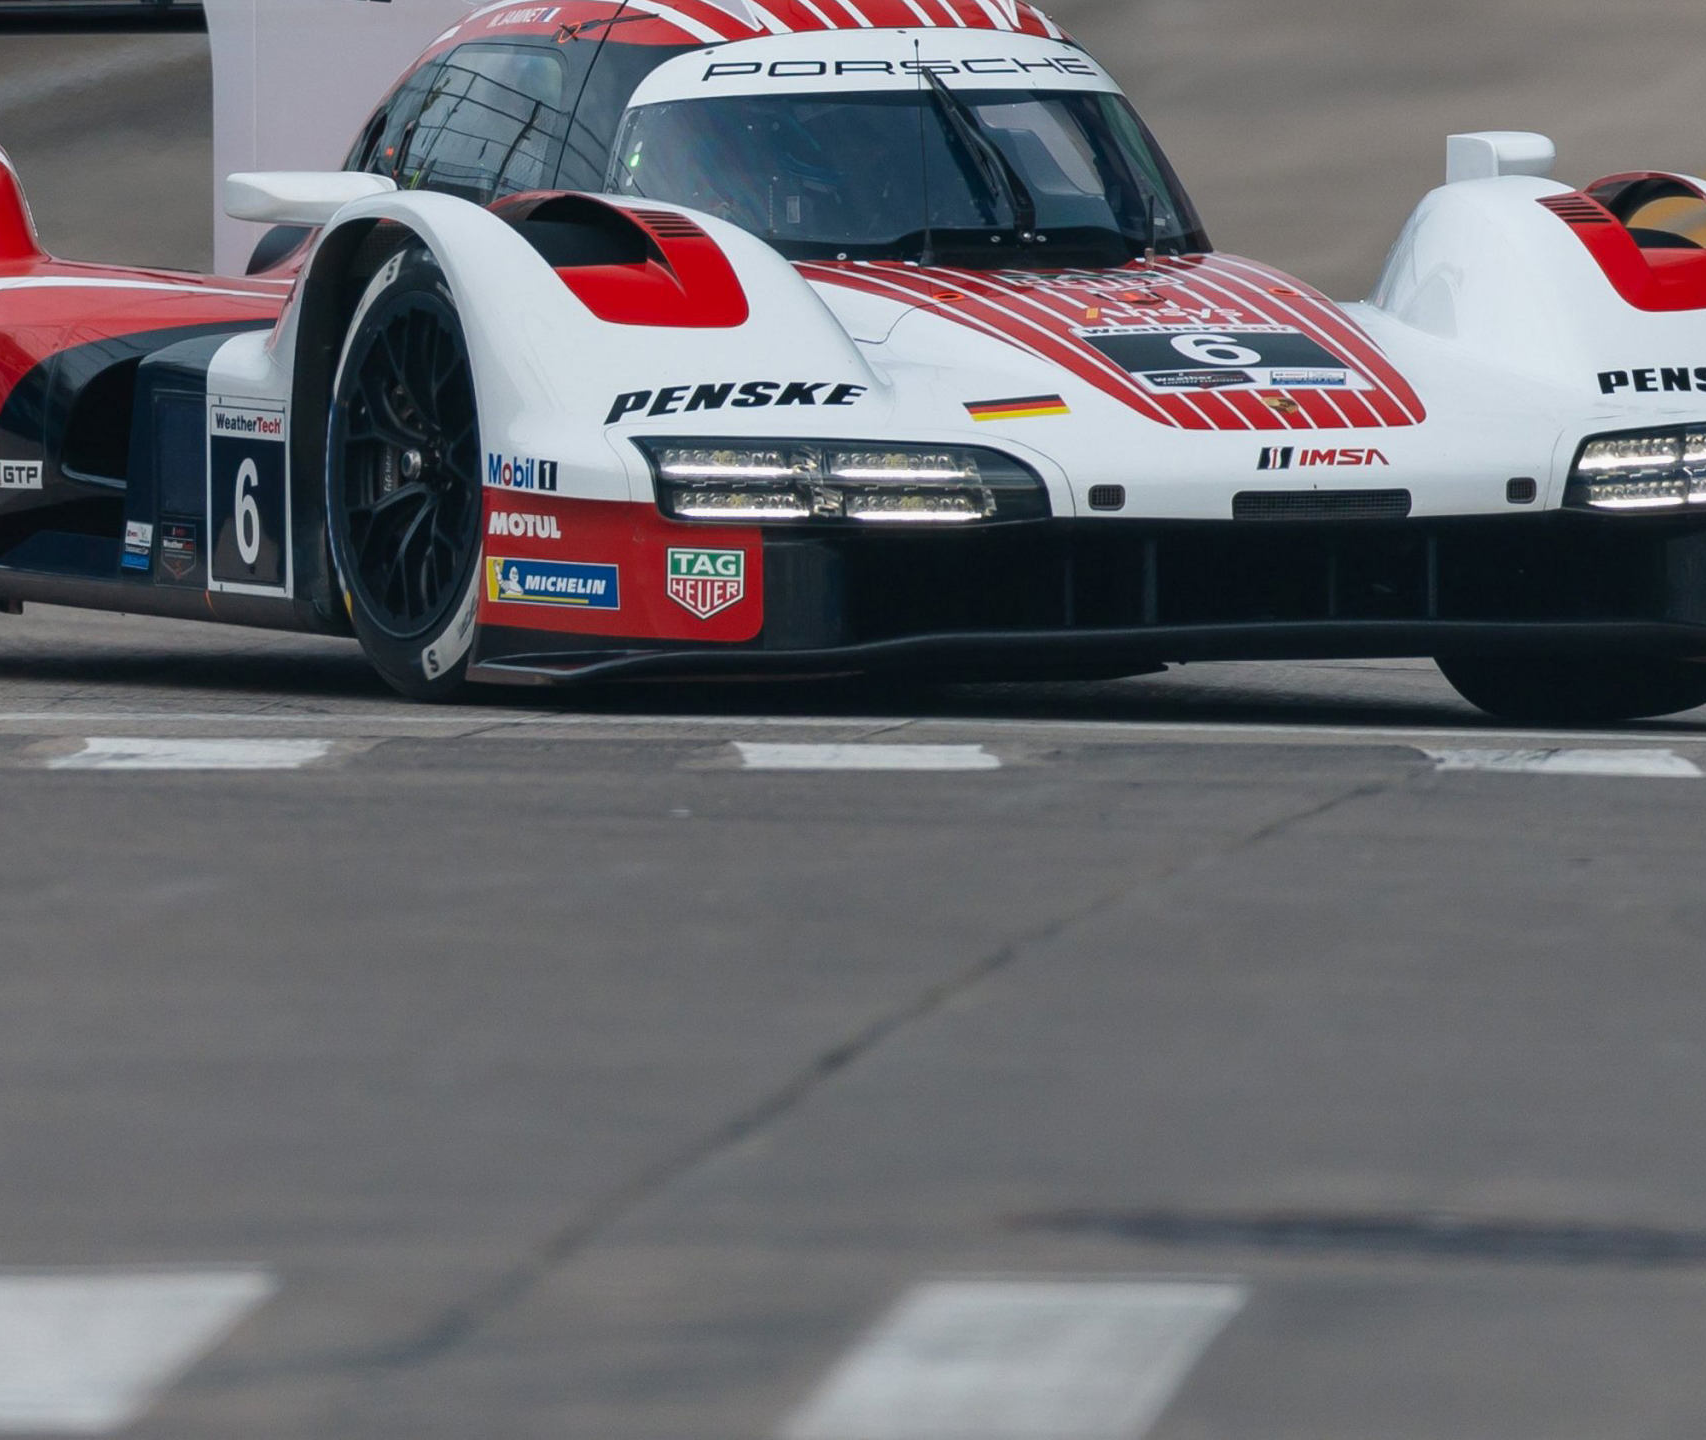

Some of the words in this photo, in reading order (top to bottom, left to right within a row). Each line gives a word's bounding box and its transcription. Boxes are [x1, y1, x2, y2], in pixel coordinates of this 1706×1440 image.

[702, 58, 1098, 81] PORSCHE
[1083, 325, 1289, 335] WeatherTech
[1169, 334, 1262, 366] 6
[603, 381, 868, 425] PENSKE
[215, 413, 282, 435] WeatherTech
[1299, 449, 1390, 466] IMSA
[3, 465, 38, 484] GTP
[488, 453, 534, 489] Mobil
[235, 458, 260, 564] 6
[488, 511, 561, 539] MOTUL
[674, 554, 736, 575] TAG
[525, 574, 607, 595] MICHELIN
[672, 578, 738, 613] HEUER
